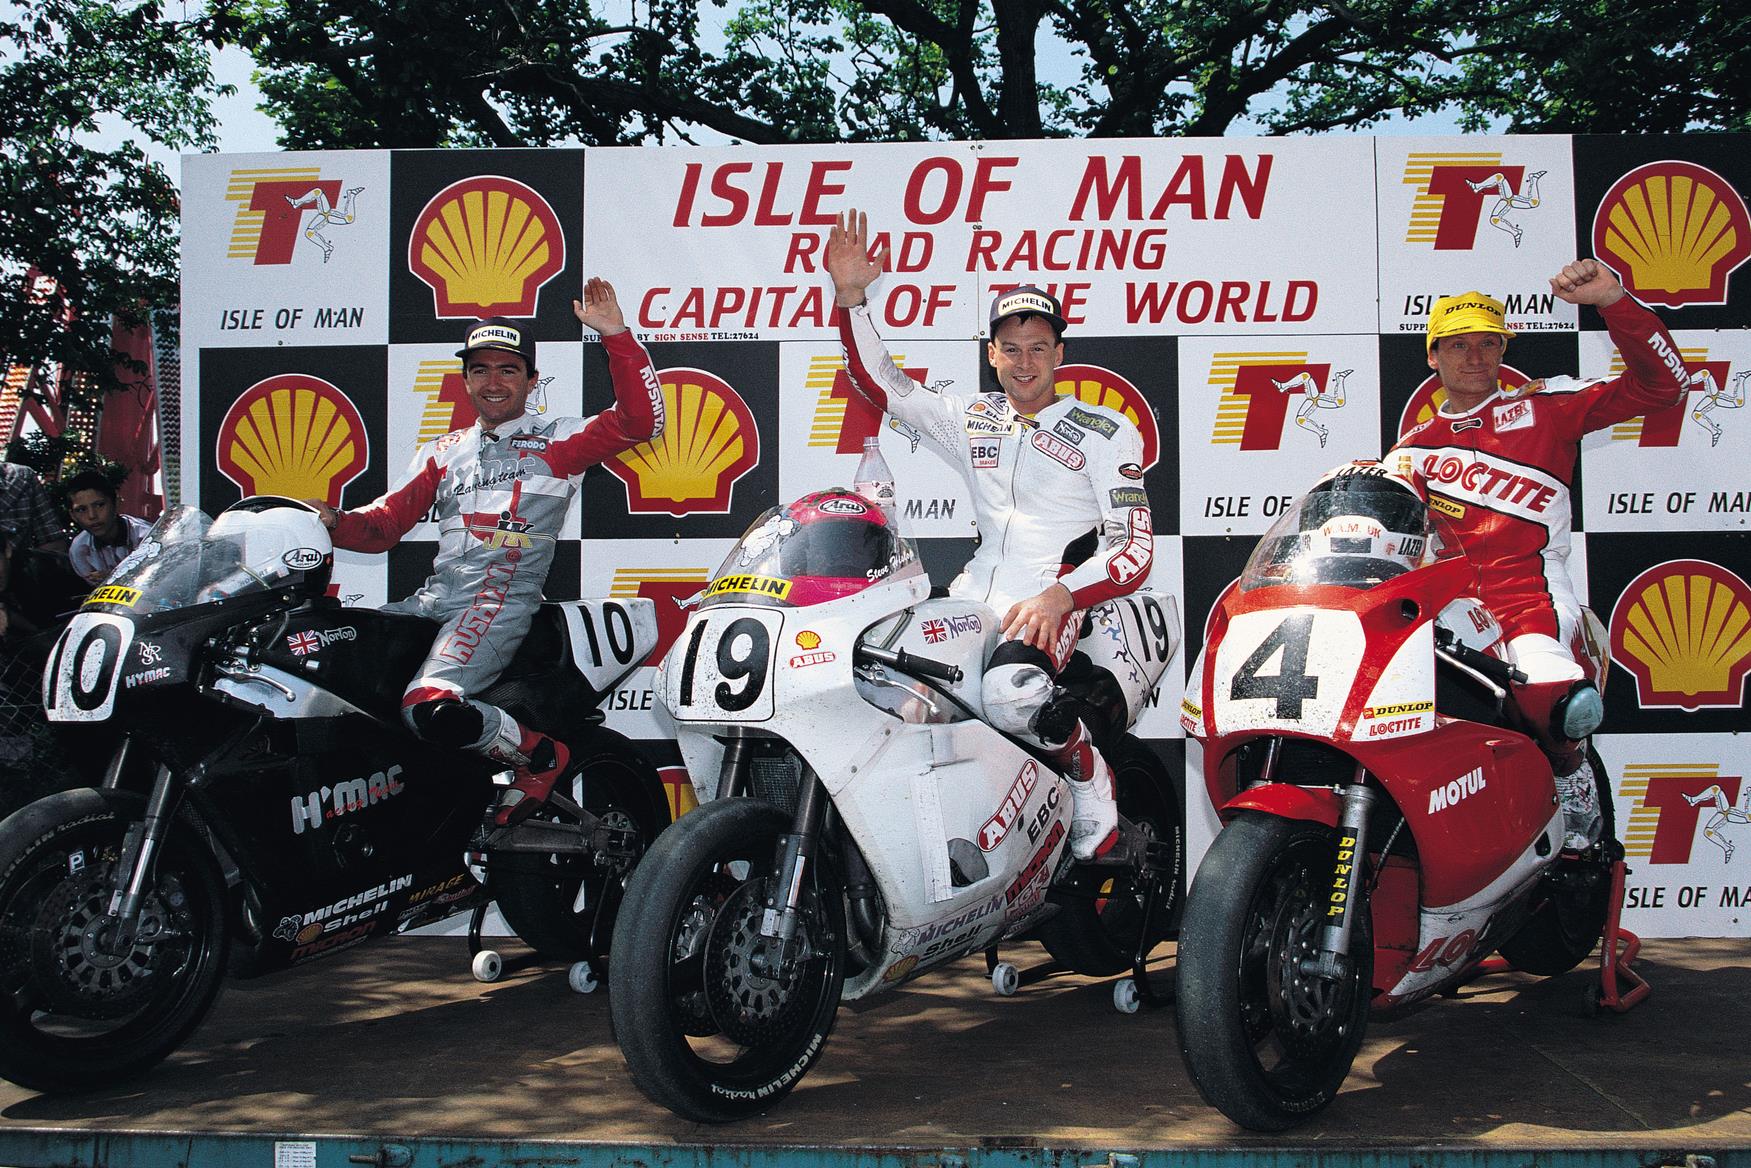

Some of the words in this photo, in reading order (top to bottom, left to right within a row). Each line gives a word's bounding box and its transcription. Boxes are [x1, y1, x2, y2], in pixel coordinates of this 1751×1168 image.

[673, 160, 853, 228] ISLE
[903, 156, 1019, 226] OF
[1068, 153, 1274, 221] MAN
[784, 231, 934, 274] RAD
[965, 229, 1168, 273] RACING
[220, 309, 264, 331] ISLE
[275, 308, 302, 330] OF
[314, 307, 365, 329] MAN
[884, 284, 957, 327] OF
[1125, 280, 1319, 325] WORLD
[1002, 297, 1051, 313] MICHELIN
[1444, 302, 1502, 317] DUNLOP
[471, 329, 518, 342] MICHELIN
[654, 333, 677, 341] SIGN
[680, 332, 709, 341] SENSE
[1495, 402, 1527, 427] LAZER
[511, 440, 547, 450] FERODO
[972, 445, 999, 459] EBC
[1036, 432, 1085, 469] ABUS
[1423, 454, 1558, 513] LOCTITE
[903, 498, 957, 521] MAN
[1204, 496, 1251, 518] ISLE
[1262, 495, 1293, 517] OF
[1607, 493, 1655, 514] ISLE
[1666, 492, 1697, 514] OF
[1110, 508, 1152, 584] ABUS
[704, 576, 787, 596] MICHELIN
[315, 625, 358, 648] Norton
[578, 601, 635, 668] 10
[943, 614, 983, 639] Norton
[1127, 596, 1170, 664] 19
[48, 622, 122, 712] 10
[679, 616, 771, 713] 19
[791, 651, 835, 668] ABUS
[1230, 613, 1319, 720] 4
[607, 690, 654, 711] ISLE
[1375, 701, 1434, 716] DUNLOP
[1369, 716, 1422, 737] LOCTITE
[982, 762, 1036, 850] ABUS
[1428, 766, 1487, 815] MOTUL
[1026, 785, 1060, 845] EBC
[1327, 836, 1356, 916] DUNLOP
[303, 873, 413, 926] MICHELIN
[1677, 886, 1707, 908] OF
[323, 900, 389, 933] Shell
[916, 895, 1004, 946] MICHELIN
[924, 923, 983, 957] Shell
[757, 1033, 822, 1098] MICHELIN
